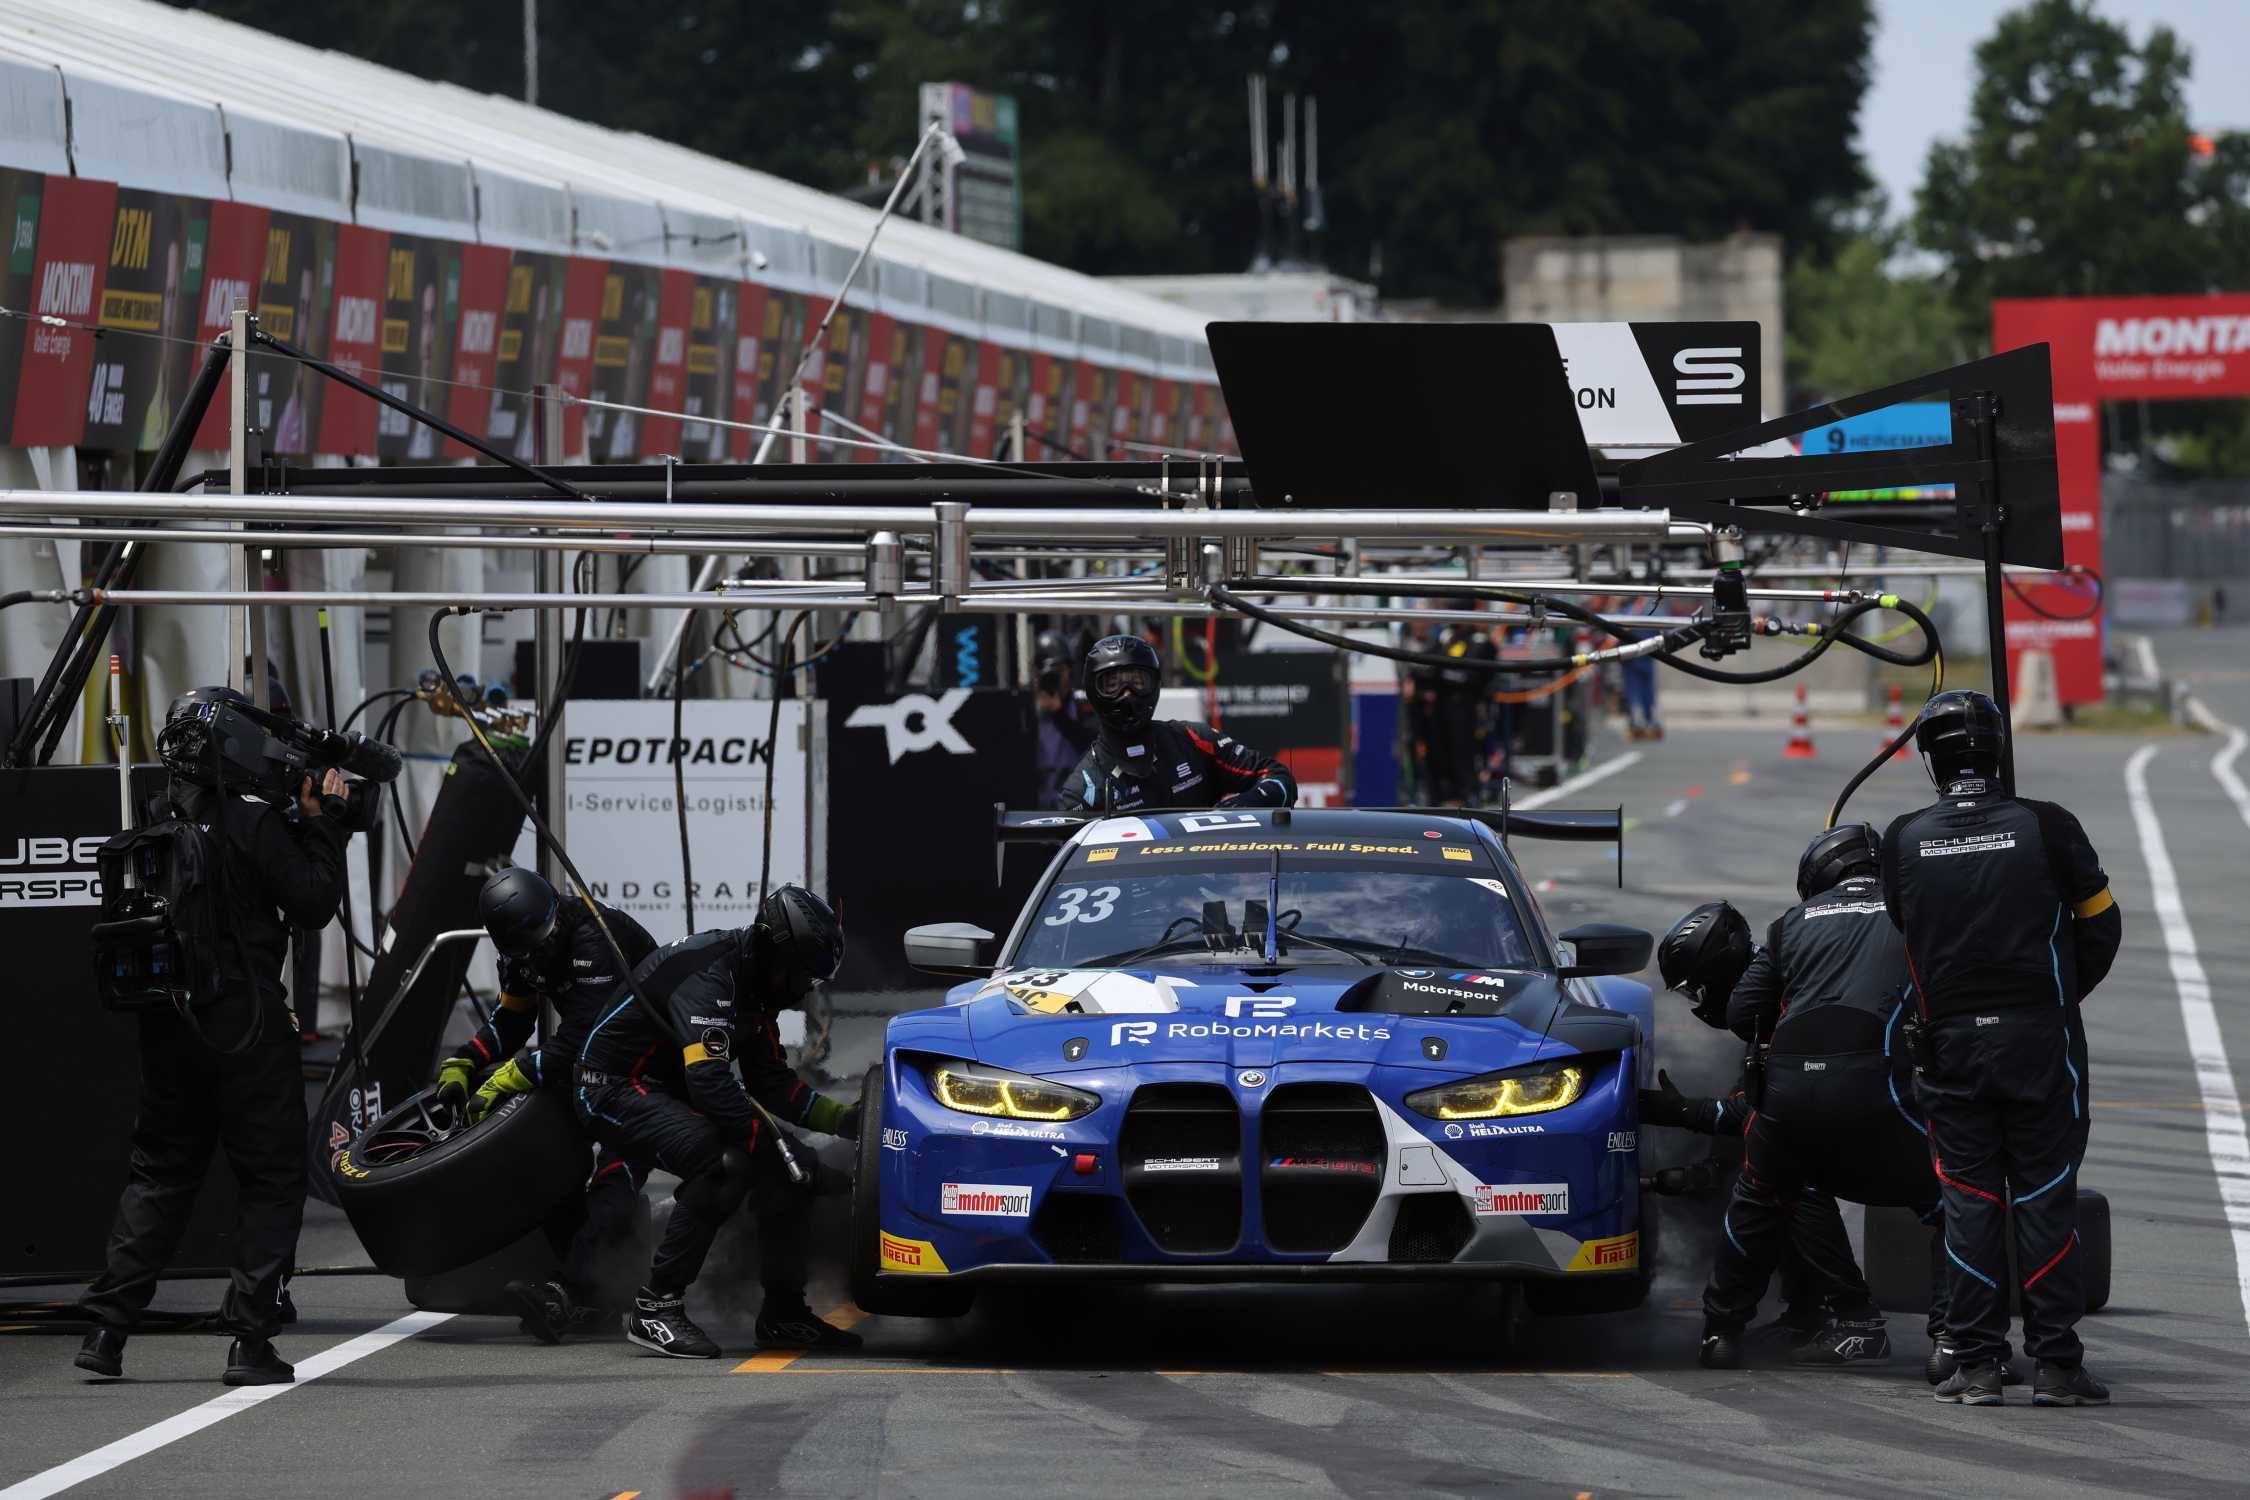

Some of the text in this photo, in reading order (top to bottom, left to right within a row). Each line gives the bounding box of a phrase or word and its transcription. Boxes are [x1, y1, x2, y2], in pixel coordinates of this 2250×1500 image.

[112, 208, 152, 270] DTM
[1573, 387, 1616, 409] ON
[1828, 428, 1845, 453] 9
[1140, 842, 1419, 855] Less emissions. Full Speed.
[1920, 832, 2016, 848] SCHUBERT
[1924, 842, 2013, 856] MOTORSPORT
[1044, 886, 1121, 927] 33
[1008, 973, 1070, 987] 33
[1403, 981, 1499, 1002] Motorsport
[1168, 1021, 1392, 1041] RoboMarkets
[882, 1127, 909, 1148] ENDLESS
[1029, 1129, 1065, 1139] ULTRA
[1471, 1125, 1545, 1136] HELIX ULTRA
[1607, 1131, 1637, 1149] ENDLESS
[958, 1191, 1030, 1214] motorsport
[1494, 1191, 1567, 1213] motorsport
[883, 1237, 921, 1265] PIRELLI
[1595, 1237, 1637, 1264] PIRELLI
